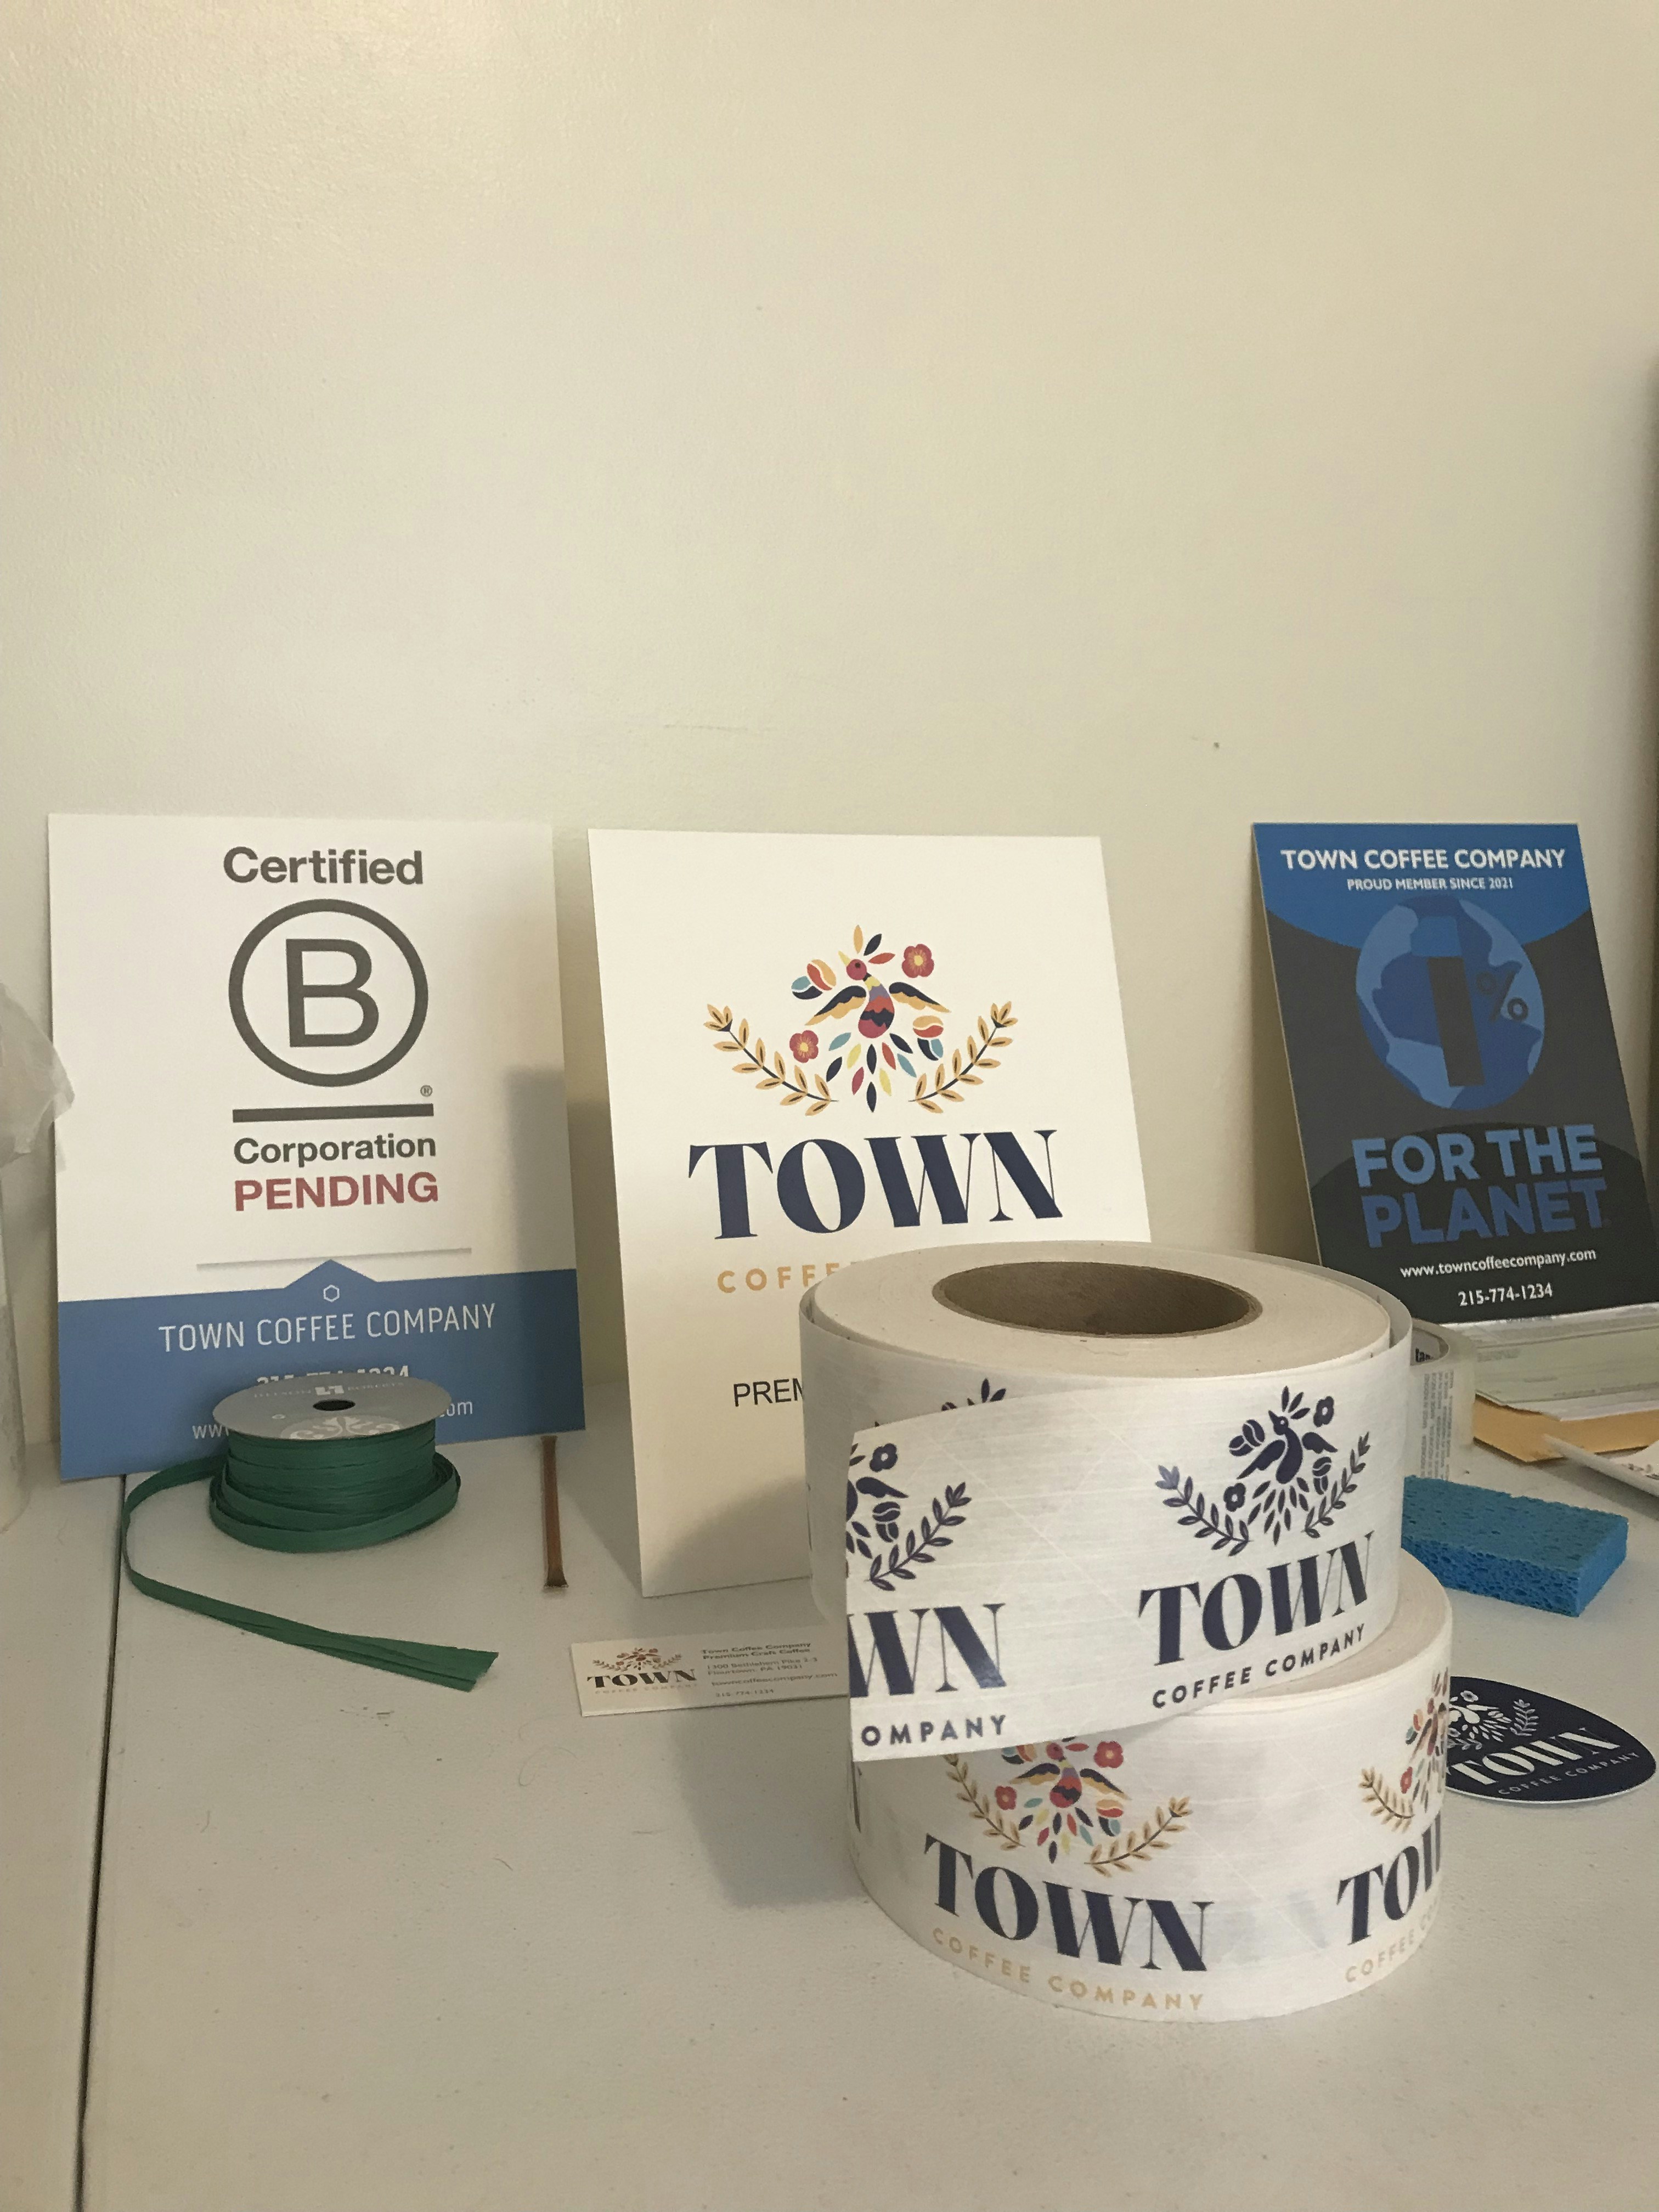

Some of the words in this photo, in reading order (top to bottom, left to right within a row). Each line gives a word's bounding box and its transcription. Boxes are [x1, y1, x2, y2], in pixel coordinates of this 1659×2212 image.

[223, 845, 424, 885] Certified
[1280, 849, 1358, 870] TOWN
[1363, 849, 1448, 870] COFFEE
[1454, 848, 1566, 868] COMPANY
[1347, 878, 1392, 891] PROUD
[1395, 878, 1447, 890] MEMBER
[1449, 878, 1485, 890] SINCE
[1488, 878, 1513, 889] 2021
[285, 938, 379, 1048] B
[234, 1132, 436, 1167] Corporation
[1352, 1133, 1480, 1188] FOR
[1486, 1124, 1602, 1178] THE
[235, 1171, 439, 1211] PENDING
[689, 1130, 1063, 1239] TOWN
[1362, 1178, 1607, 1248] PLANET
[1400, 1249, 1597, 1278] www.towncoffeecompany.com
[1458, 1283, 1553, 1307] 215-774-1234
[159, 1321, 245, 1353] TOWN
[257, 1313, 356, 1346] COFFEE
[366, 1303, 496, 1337] COMPANY
[1138, 1531, 1373, 1666] TOWN
[587, 1669, 698, 1688] TOWN
[1152, 1666, 1252, 1708] COFFEE
[1265, 1624, 1366, 1677] COMPANY
[1446, 1727, 1621, 1785] TOWN
[1498, 1774, 1562, 1795] COFFEE
[1565, 1752, 1640, 1777] COMPANY
[924, 1833, 1215, 1972] TOWN
[933, 1927, 1030, 1983] COFFEE
[1048, 1976, 1204, 2011] COMPANY
